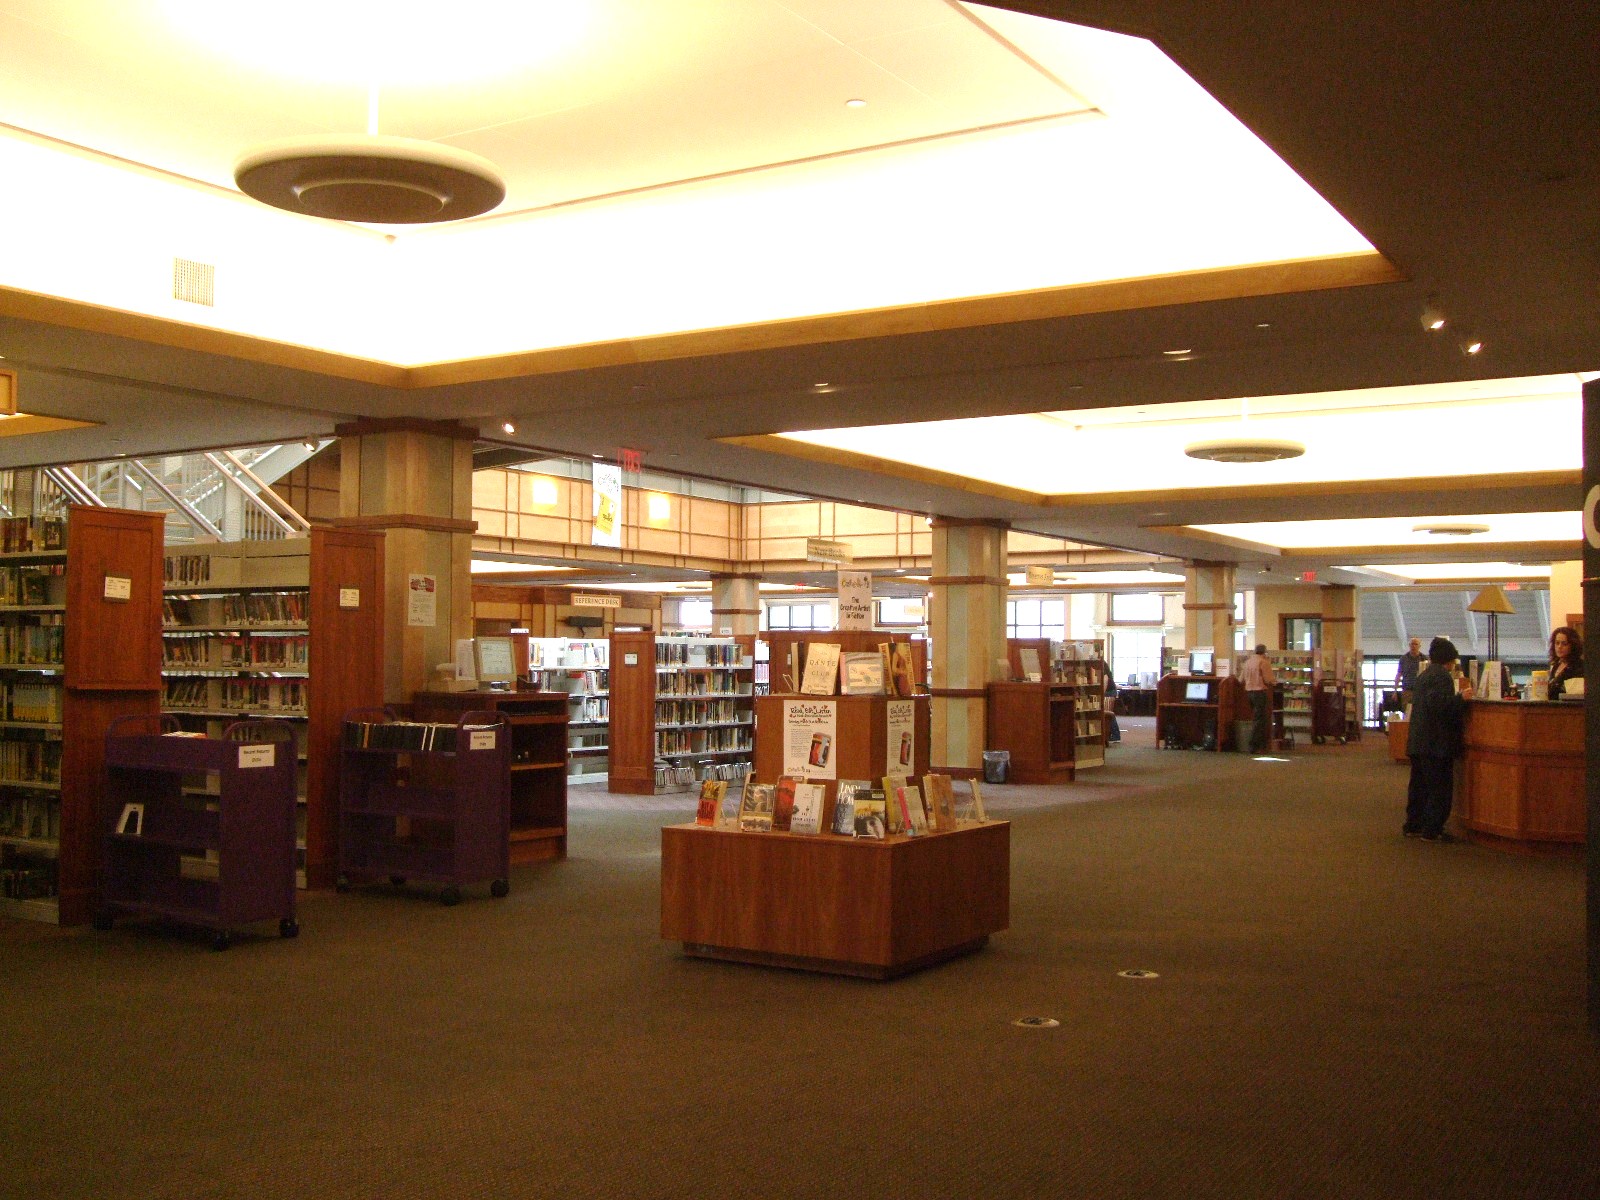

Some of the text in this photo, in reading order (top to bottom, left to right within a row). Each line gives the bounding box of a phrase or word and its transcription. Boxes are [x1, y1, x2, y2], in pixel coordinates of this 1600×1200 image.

[575, 597, 619, 606] REFERENCE DESK
[809, 659, 837, 667] DANTE
